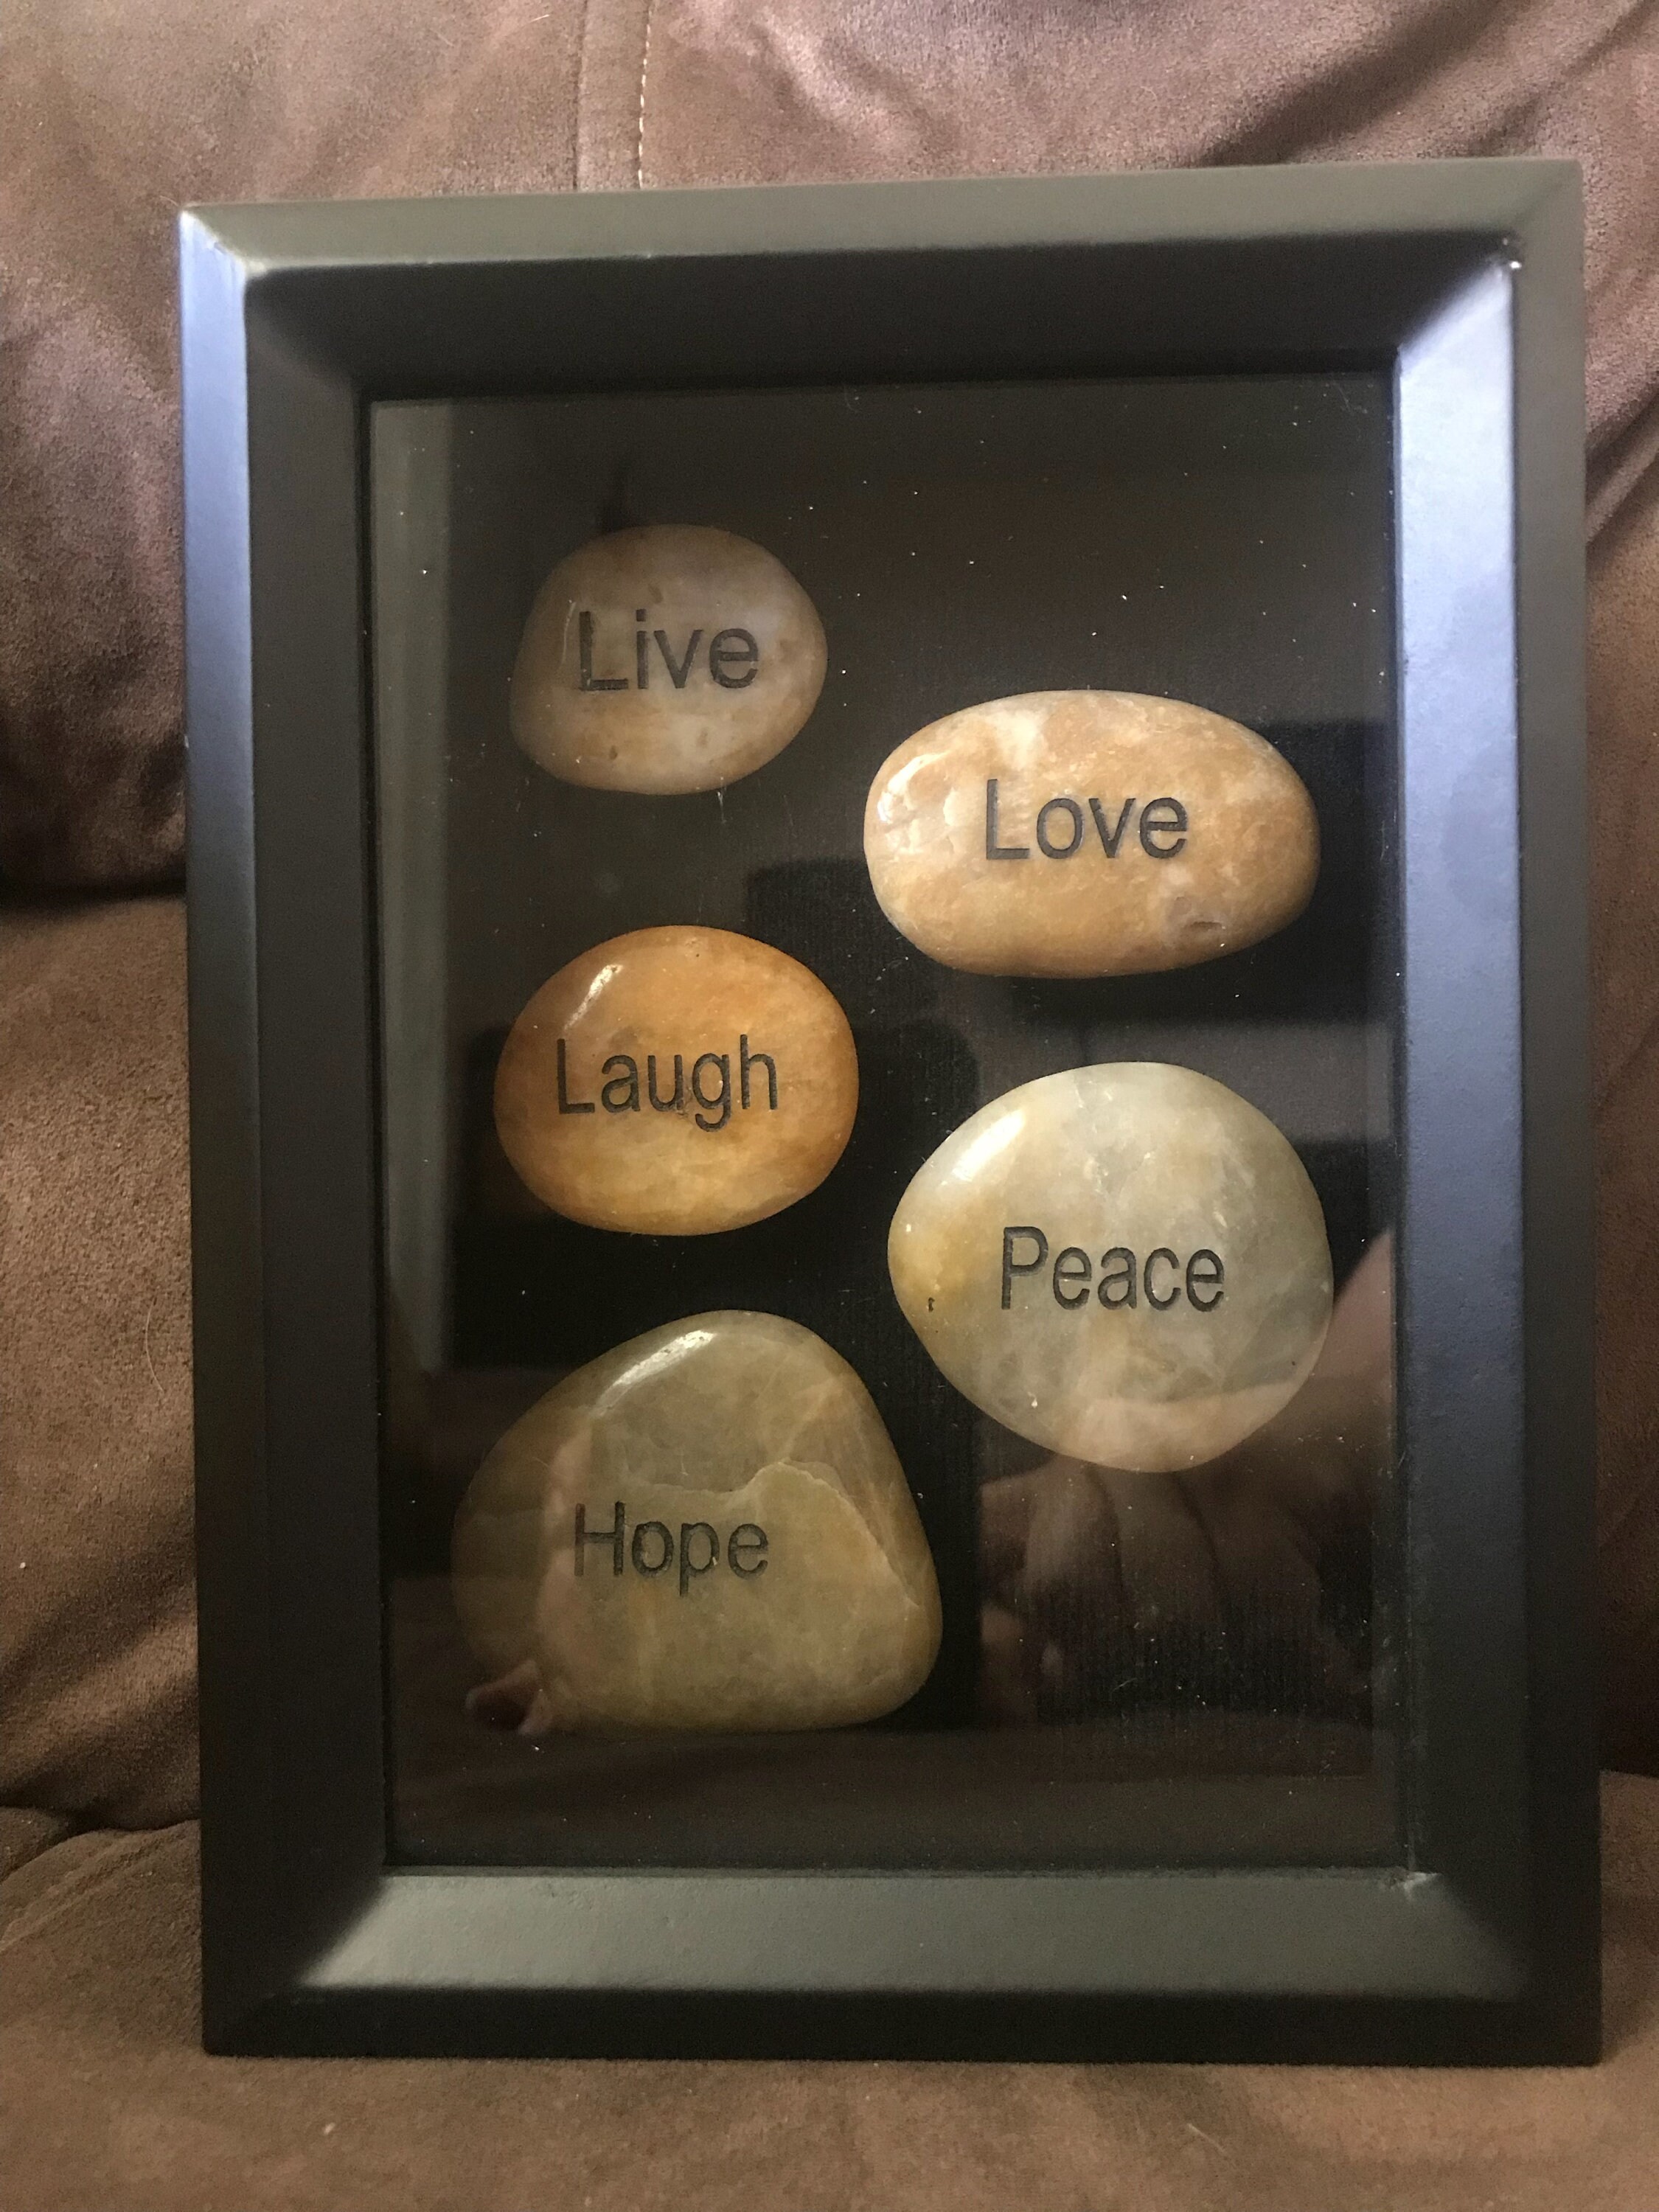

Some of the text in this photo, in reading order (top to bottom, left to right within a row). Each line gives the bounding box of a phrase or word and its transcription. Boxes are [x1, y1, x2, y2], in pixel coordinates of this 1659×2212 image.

[579, 609, 759, 692] Live
[986, 778, 1188, 861] Love
[557, 1034, 778, 1132] Laugh
[1001, 1226, 1224, 1312] Peace
[574, 1500, 770, 1598] Hope
